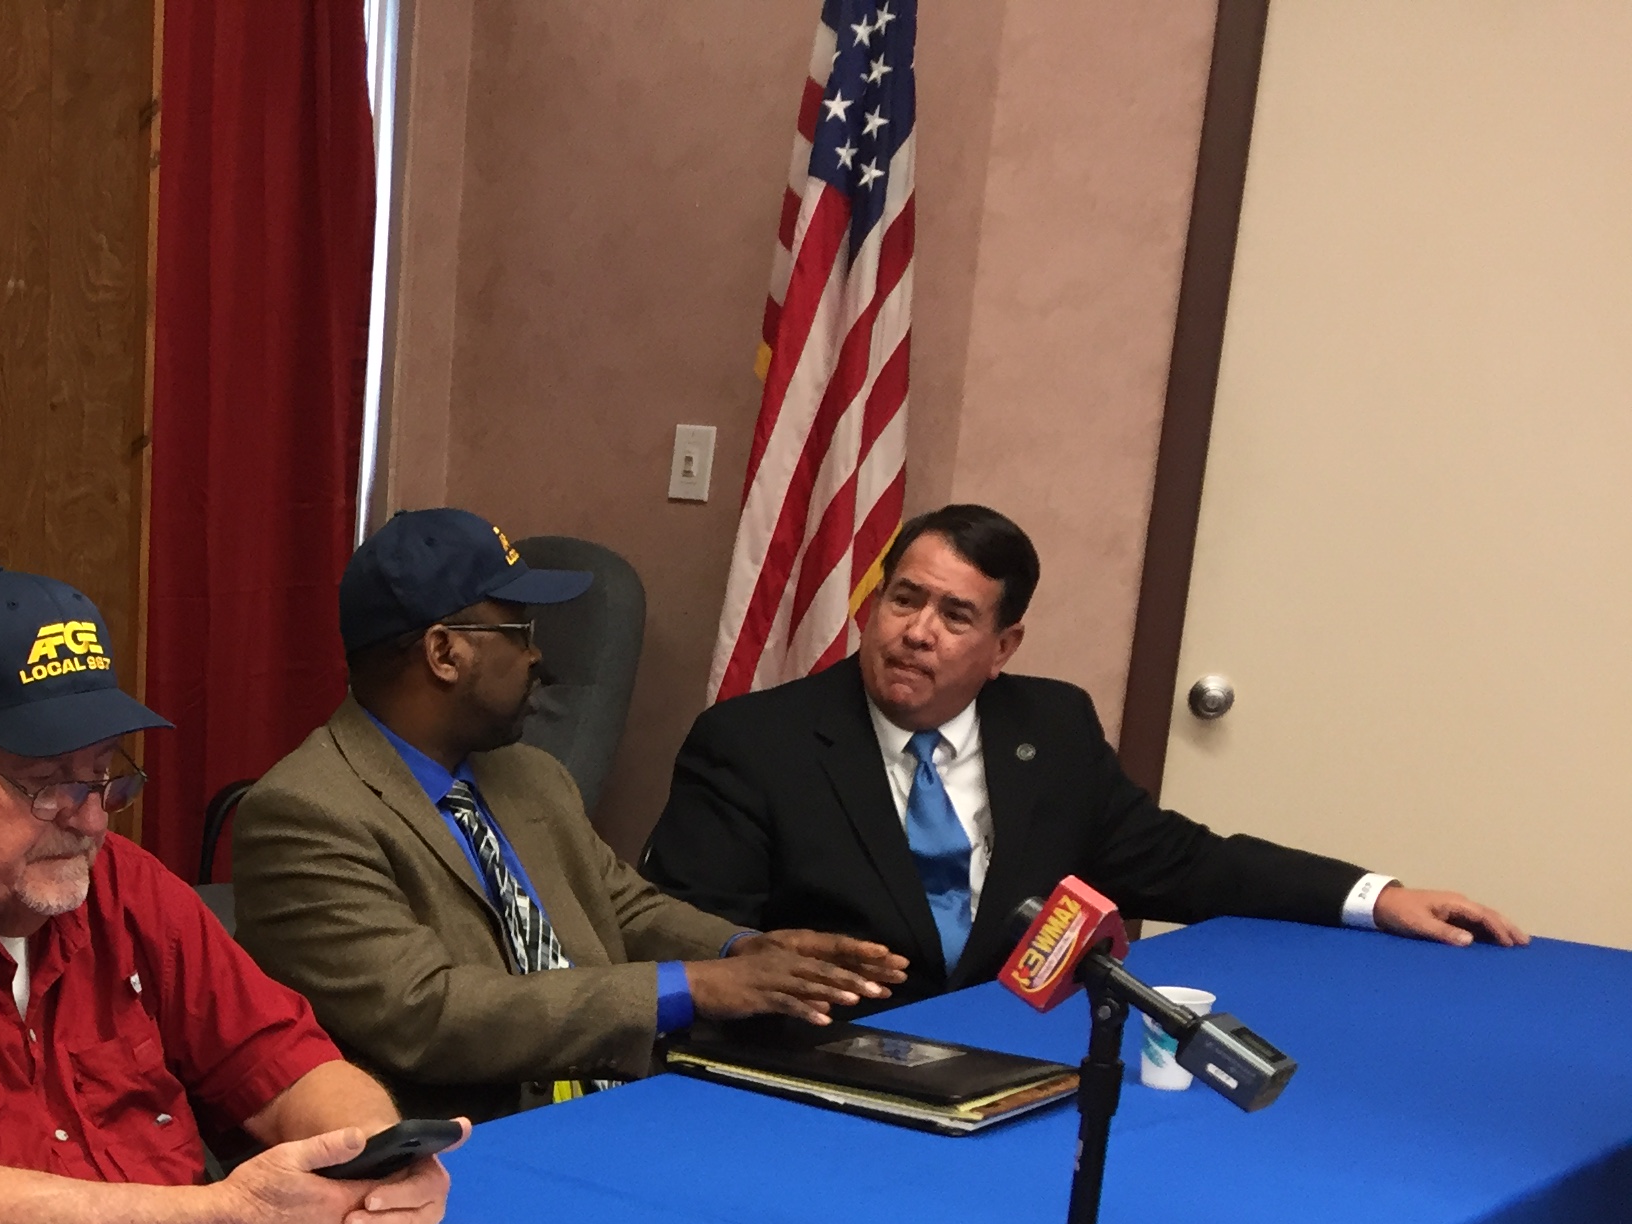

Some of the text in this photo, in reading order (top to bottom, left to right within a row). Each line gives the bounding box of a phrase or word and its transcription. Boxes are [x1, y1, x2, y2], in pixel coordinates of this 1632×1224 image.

[27, 620, 104, 664] AFGE
[19, 655, 111, 684] LOCAL 987
